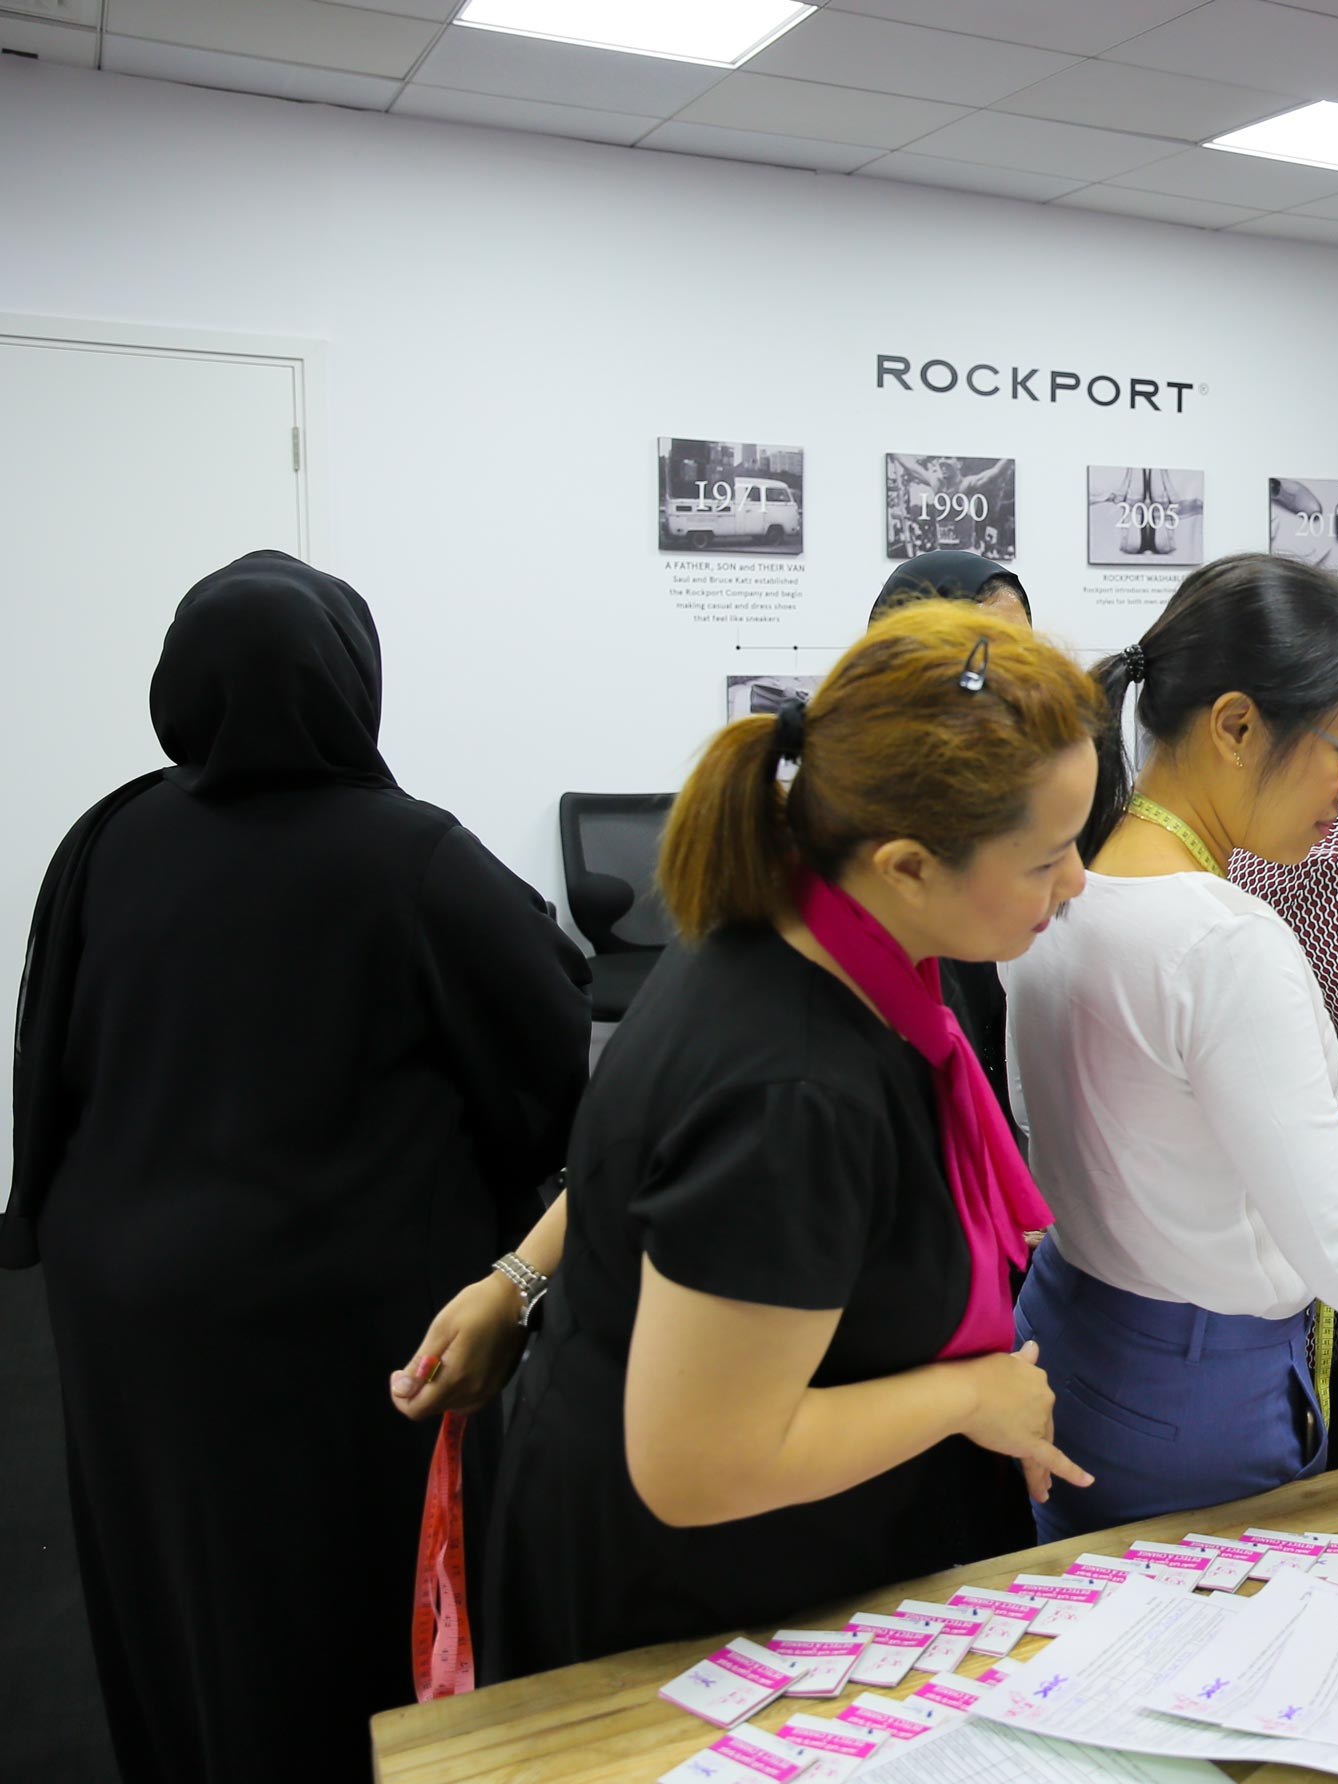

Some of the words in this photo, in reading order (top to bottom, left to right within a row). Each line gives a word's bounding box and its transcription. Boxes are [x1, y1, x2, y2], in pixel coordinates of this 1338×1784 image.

[877, 354, 1194, 413] ROCKPORT
[695, 481, 768, 512] 1971
[918, 492, 988, 521] 1990
[1115, 502, 1180, 530] 2005
[665, 562, 672, 570] A
[674, 562, 714, 571] FATHER,
[717, 562, 737, 571] SON
[740, 563, 756, 572] and
[758, 563, 784, 572] THEIR
[787, 564, 806, 572] VAN
[692, 576, 707, 584] and
[709, 576, 733, 584] Bruce
[1103, 574, 1144, 582] ROCKPORT
[669, 588, 683, 596] the
[686, 588, 723, 598] Rockport
[725, 589, 763, 599] Company
[1083, 586, 1113, 595] Rockport
[676, 601, 705, 611] making
[707, 602, 732, 610] casual
[735, 602, 749, 610] and
[751, 602, 773, 610] dress
[774, 602, 797, 610] shoes
[746, 615, 780, 623] sneakers
